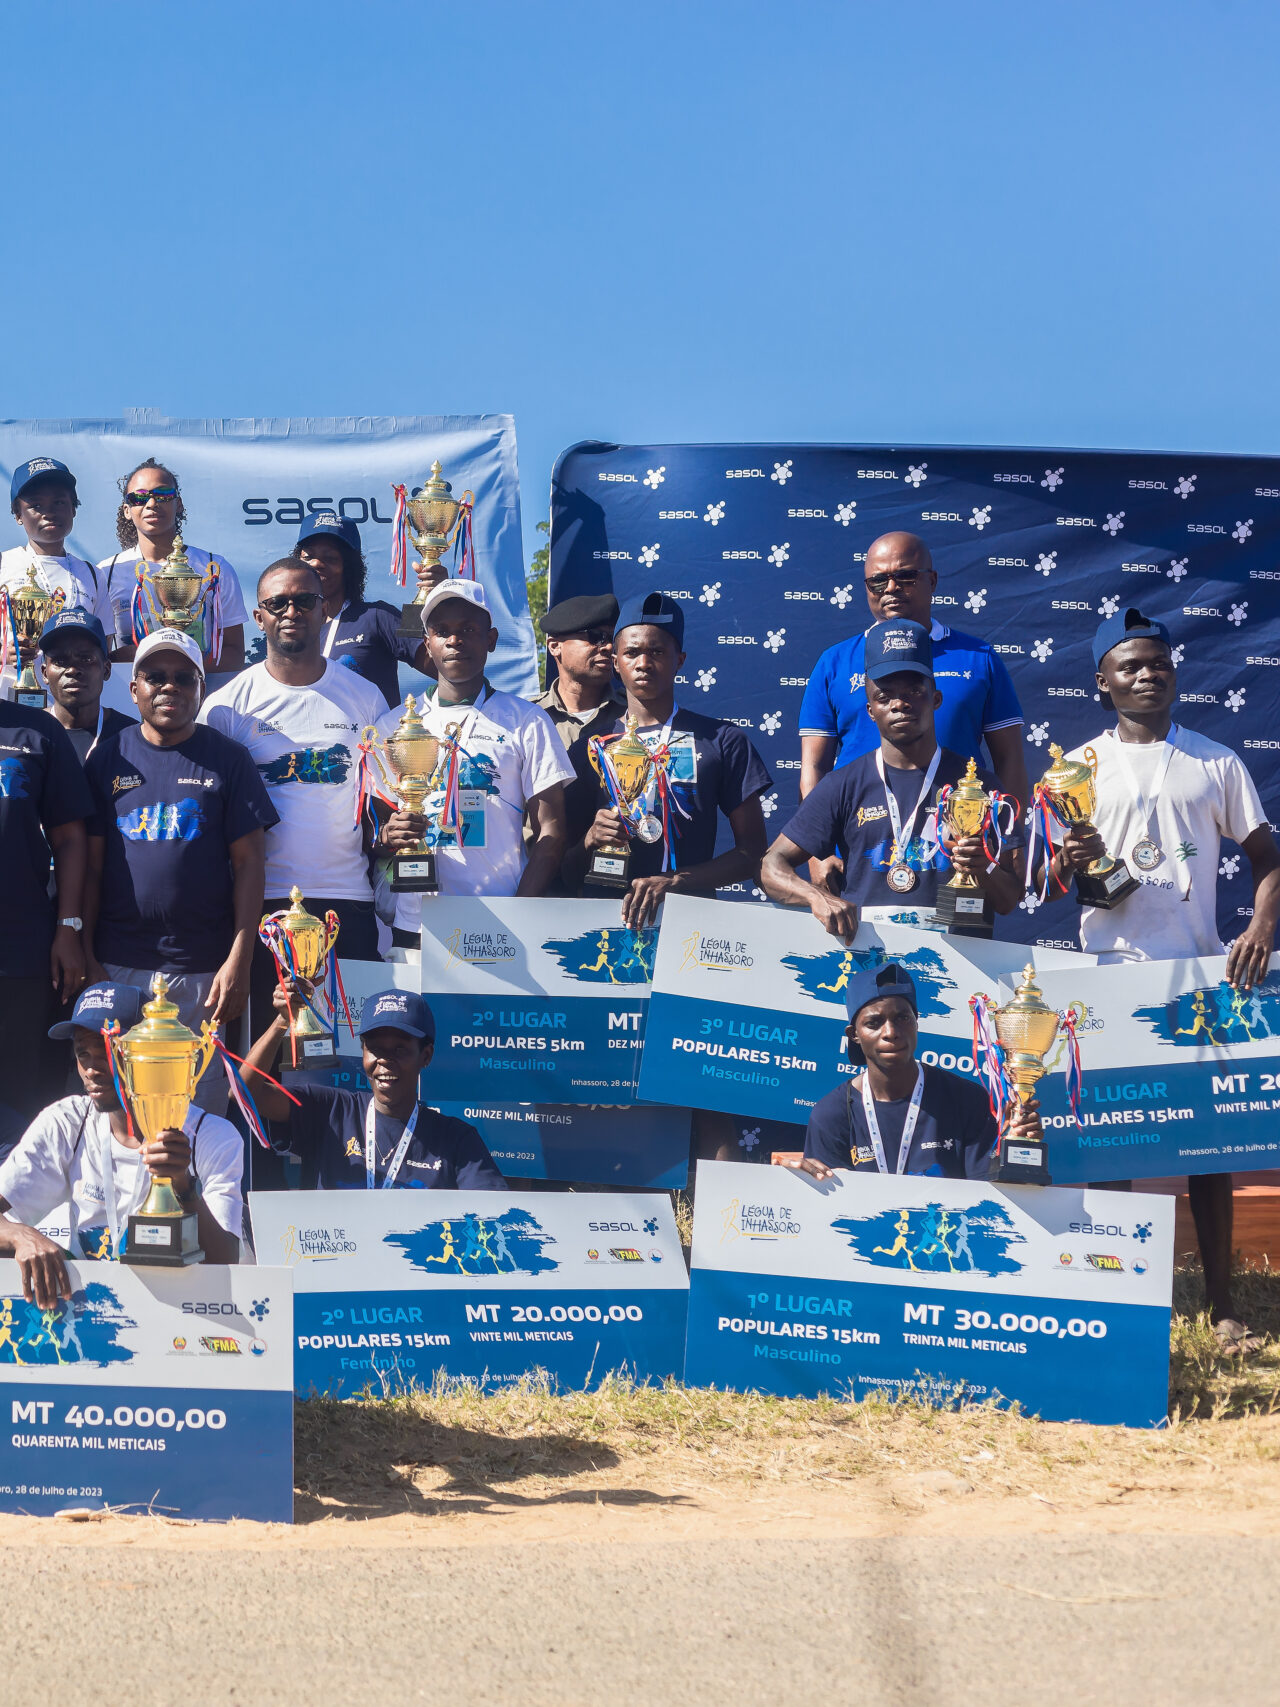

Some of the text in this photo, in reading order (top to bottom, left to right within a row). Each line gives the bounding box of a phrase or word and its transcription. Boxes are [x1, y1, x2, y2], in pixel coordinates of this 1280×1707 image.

[464, 933, 507, 945] LÉGUA DE
[700, 937, 747, 952] LÉGUA DE
[464, 944, 516, 957] INHASSORO
[700, 949, 754, 968] INHASSORO
[499, 1012, 566, 1029] LUGAR
[608, 1012, 643, 1031] MT
[728, 1021, 798, 1046] LUGAR
[451, 1035, 585, 1052] POPULARES 5km
[608, 1039, 627, 1049] DEZ
[672, 1038, 817, 1072] POPULARES 15km
[480, 1058, 556, 1071] Masculino
[837, 1063, 856, 1074] DEZ
[572, 1078, 609, 1088] Inhassoro,
[701, 1063, 780, 1088] Masculino
[1212, 1074, 1249, 1094] MT
[1094, 1082, 1168, 1103] LUGAR
[1214, 1101, 1270, 1113] VINTE MIL
[464, 1108, 572, 1124] QUINZE MIL METICAIS
[1041, 1108, 1194, 1129] POPULARES 15km
[1078, 1133, 1160, 1149] Masculino
[742, 1204, 792, 1219] LÉGUA DE
[741, 1218, 801, 1234] INHASSORO
[299, 1229, 346, 1242] LÉGUA DE
[300, 1241, 357, 1254] INHASSORO
[776, 1294, 853, 1317] LUGAR
[351, 1307, 423, 1325] LUGAR
[465, 1304, 642, 1325] MT 20.000,00
[904, 1303, 1107, 1339] MT 30.000,00
[470, 1331, 574, 1342] VINTE MIL METICAIS
[719, 1317, 880, 1344] POPULARES 15km
[298, 1332, 451, 1350] POPULARES 15km
[903, 1333, 1027, 1354] TRINTA MIL METICAIS
[754, 1344, 841, 1364] Masculino
[12, 1401, 227, 1432] MT 40.000,00
[12, 1435, 166, 1451] QUARENTA MIL METICAIS
[16, 1486, 27, 1494] 28
[29, 1485, 40, 1495] de
[42, 1485, 64, 1496] Julho
[67, 1486, 77, 1496] de
[80, 1487, 102, 1497] 2023
